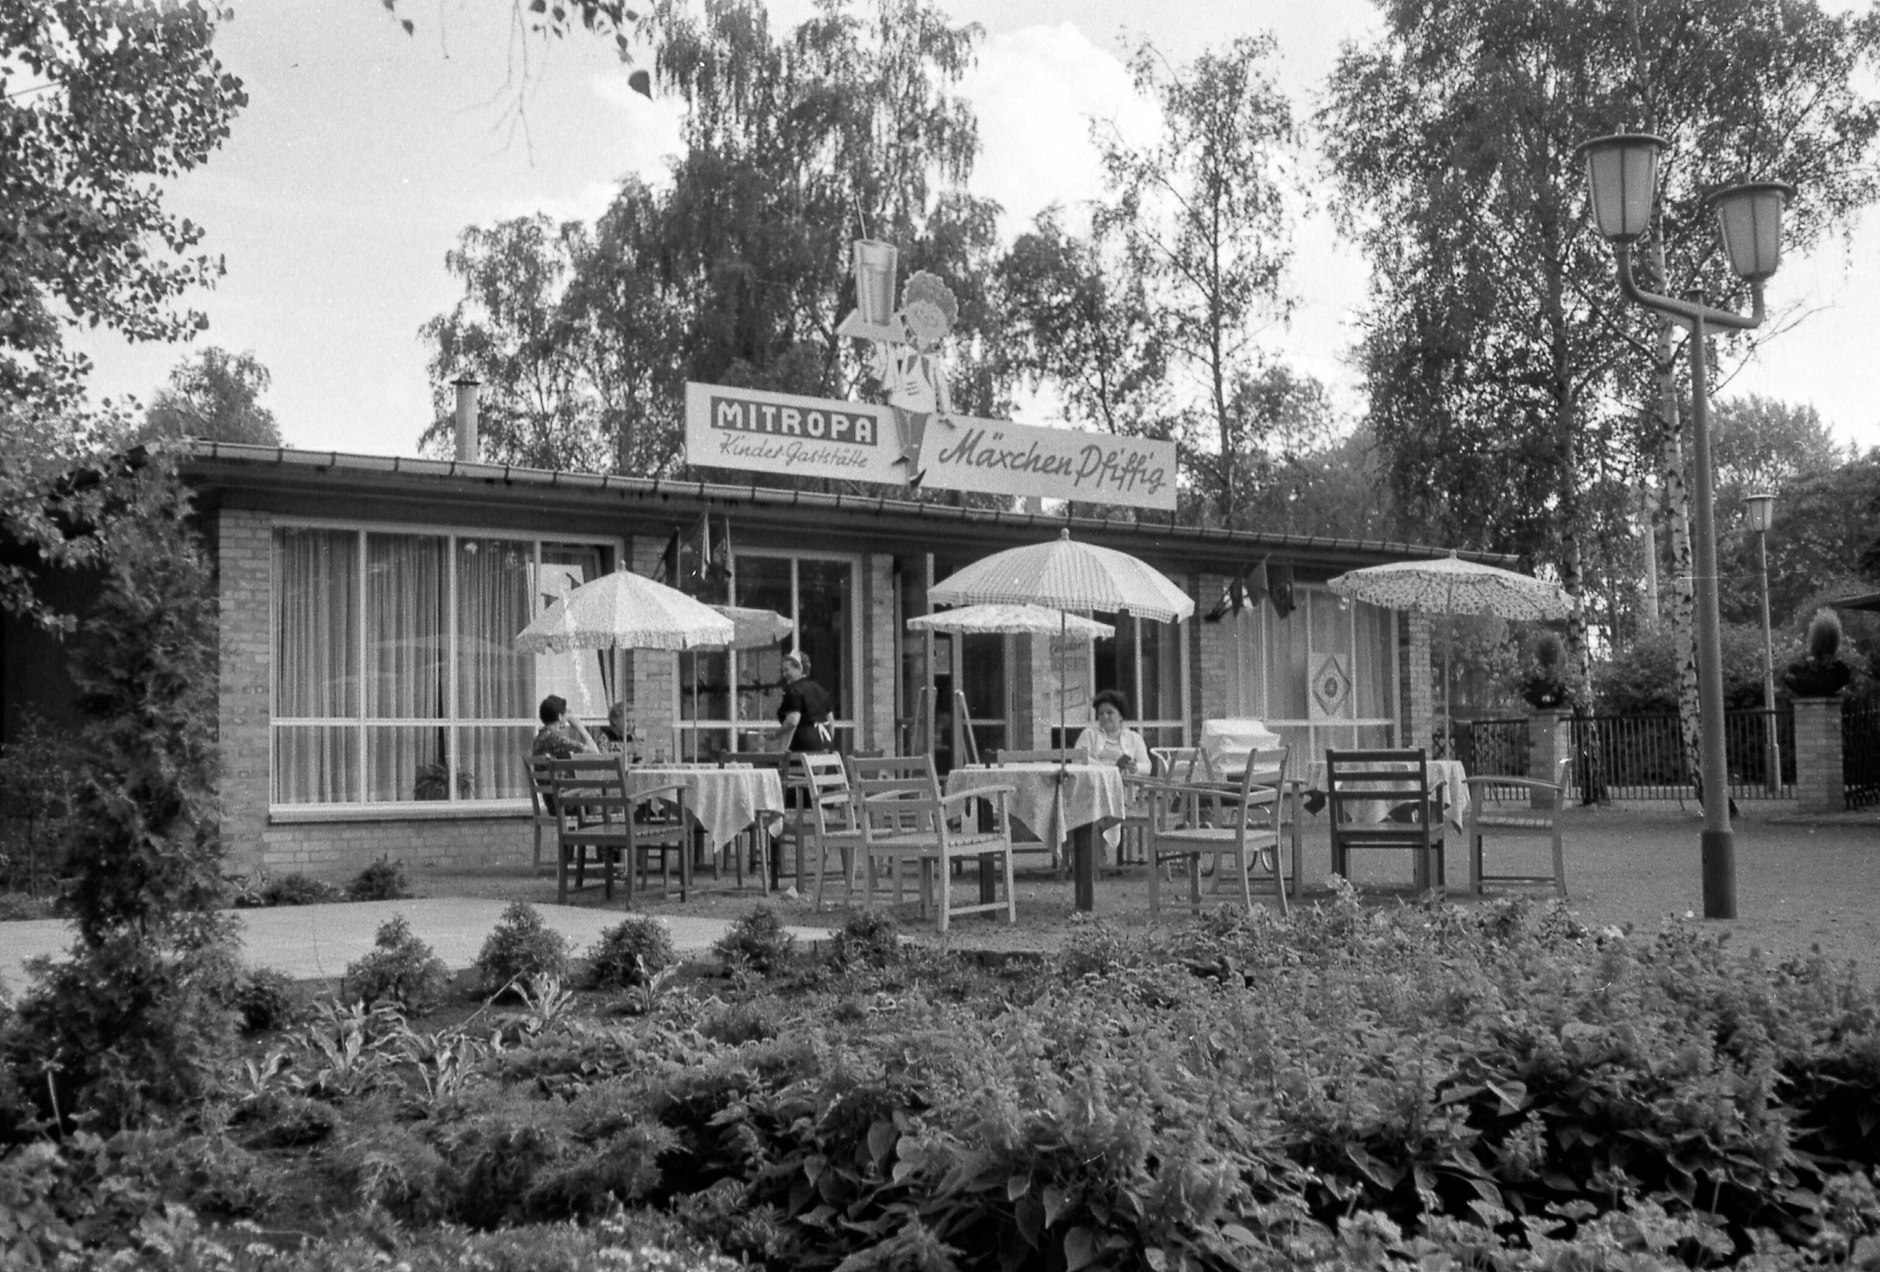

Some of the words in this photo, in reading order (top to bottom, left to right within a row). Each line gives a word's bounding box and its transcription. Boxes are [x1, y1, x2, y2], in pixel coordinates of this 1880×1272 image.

[717, 400, 872, 443] MITROPA
[938, 428, 1073, 476] Mäxchen
[1073, 444, 1167, 495] Pfiffig
